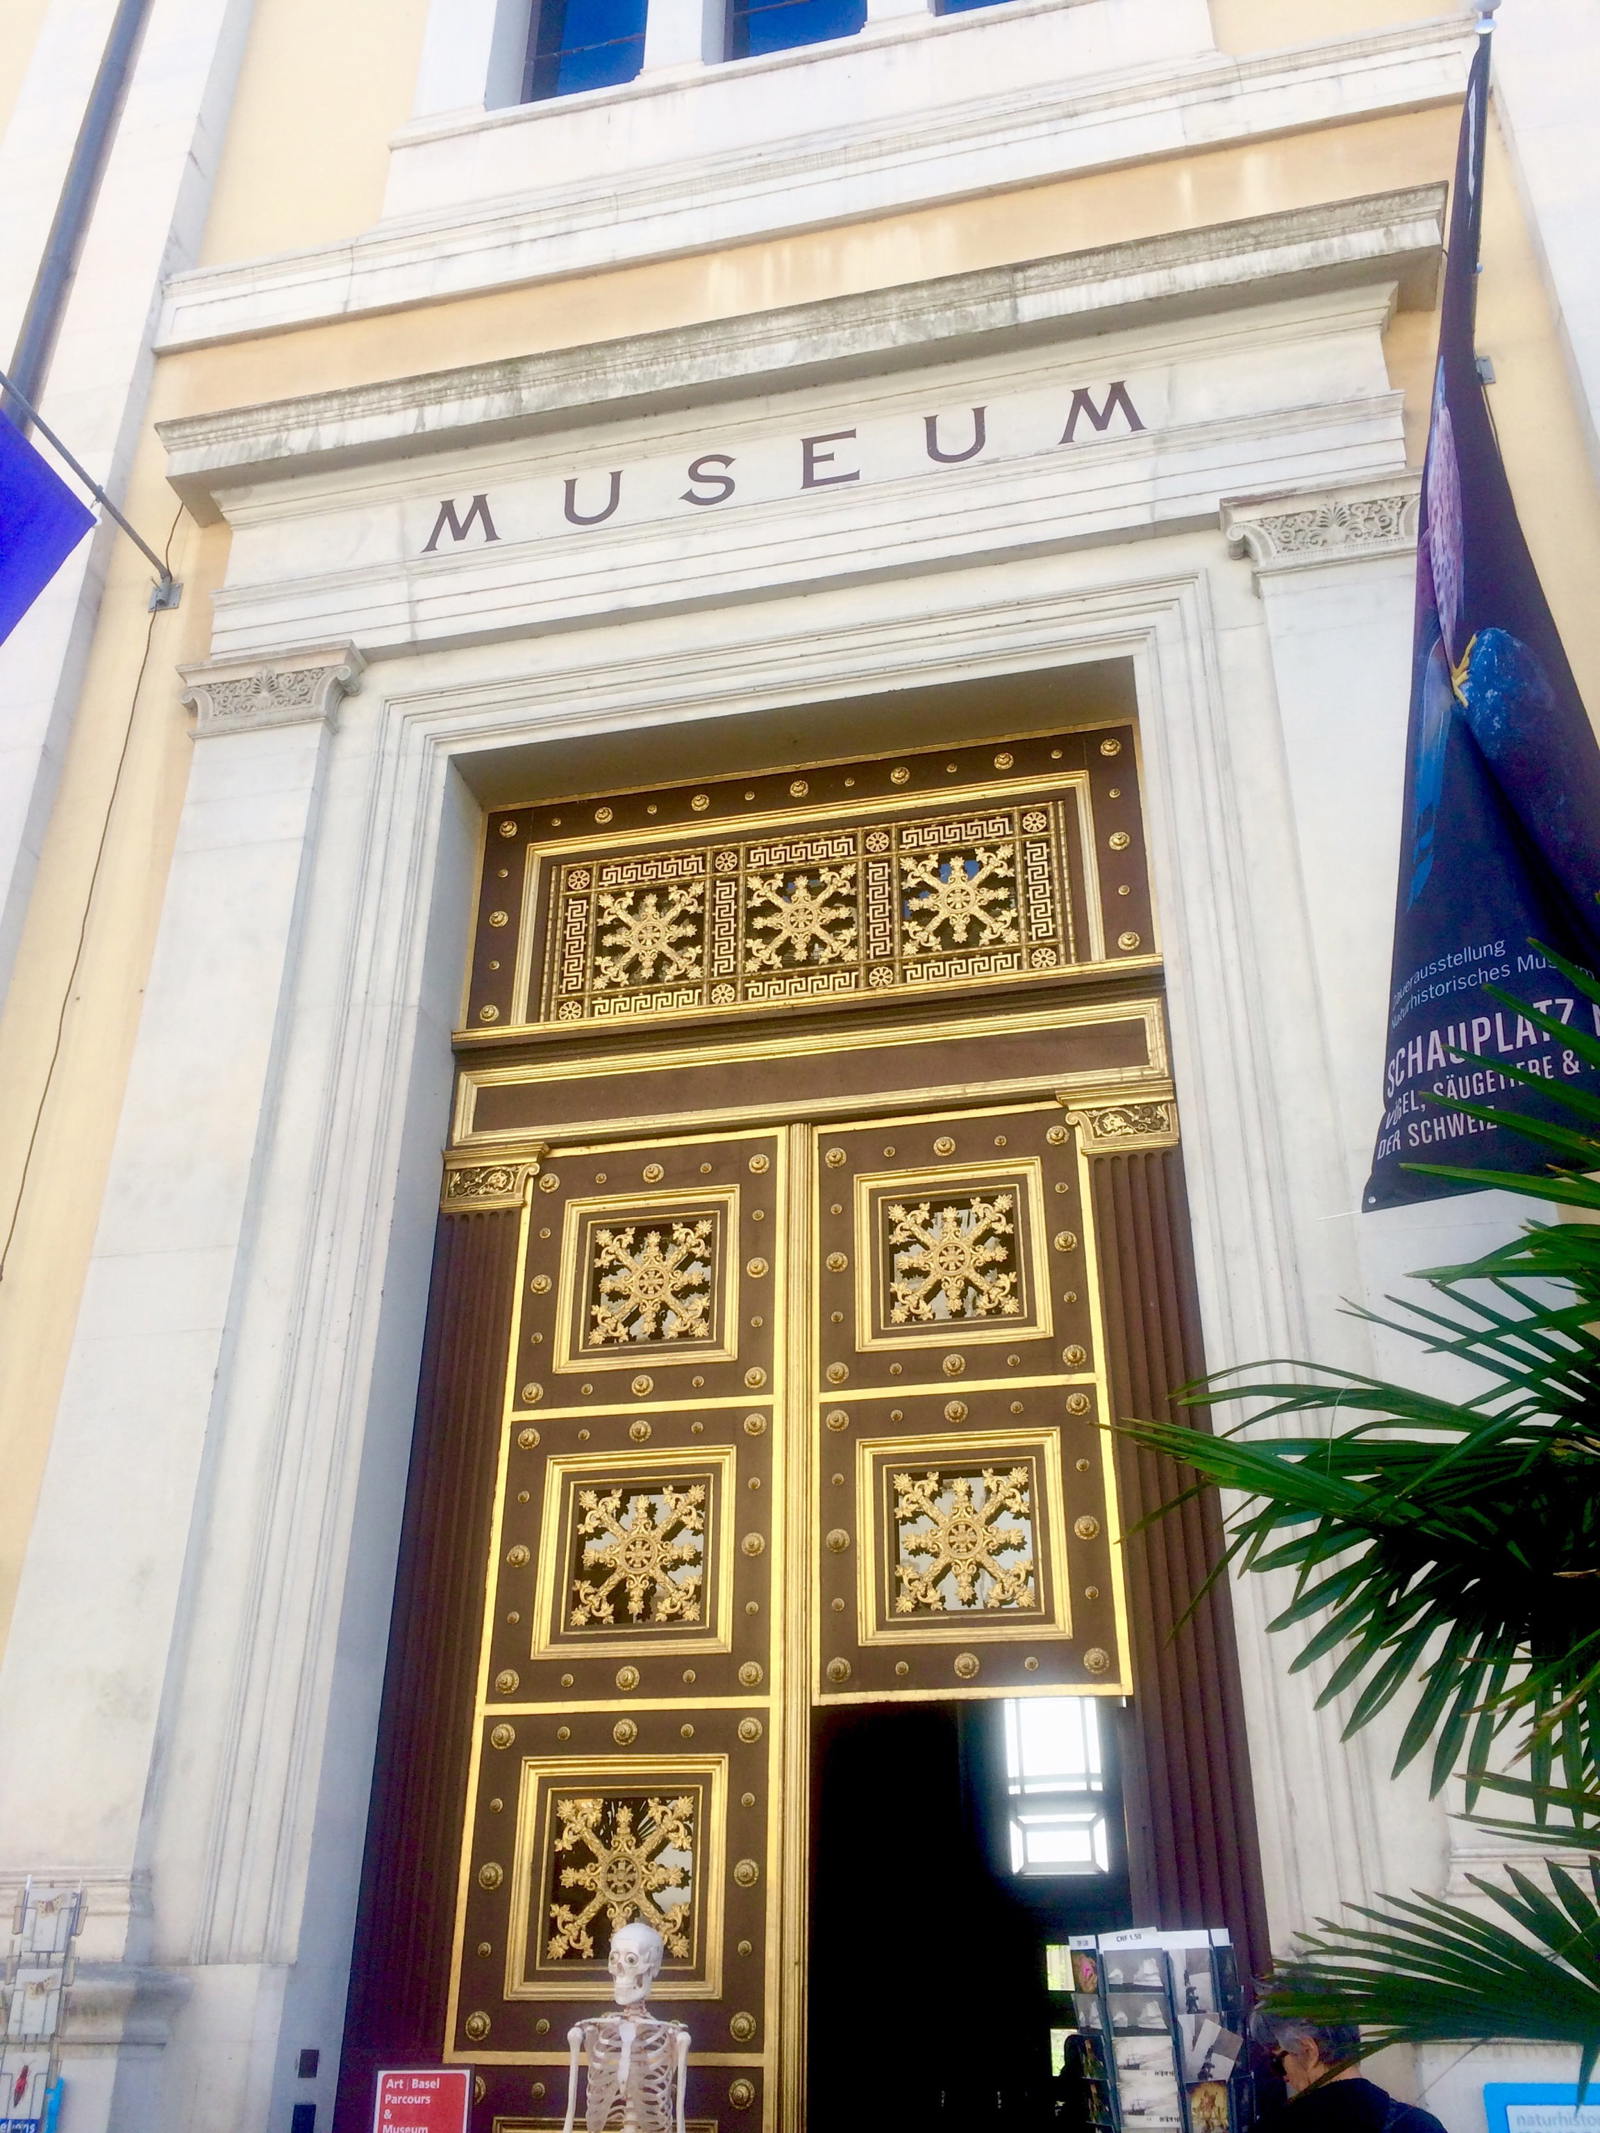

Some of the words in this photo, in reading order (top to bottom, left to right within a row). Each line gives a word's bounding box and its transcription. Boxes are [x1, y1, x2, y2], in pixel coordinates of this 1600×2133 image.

[421, 379, 1147, 554] MUSEUM
[1562, 1049, 1580, 1075] &
[1377, 1129, 1401, 1160] DER
[386, 2079, 404, 2089] Art
[411, 2077, 440, 2089] Basel
[384, 2094, 431, 2105] Parcours
[383, 2109, 392, 2120] &
[382, 2124, 428, 2133] Museum
